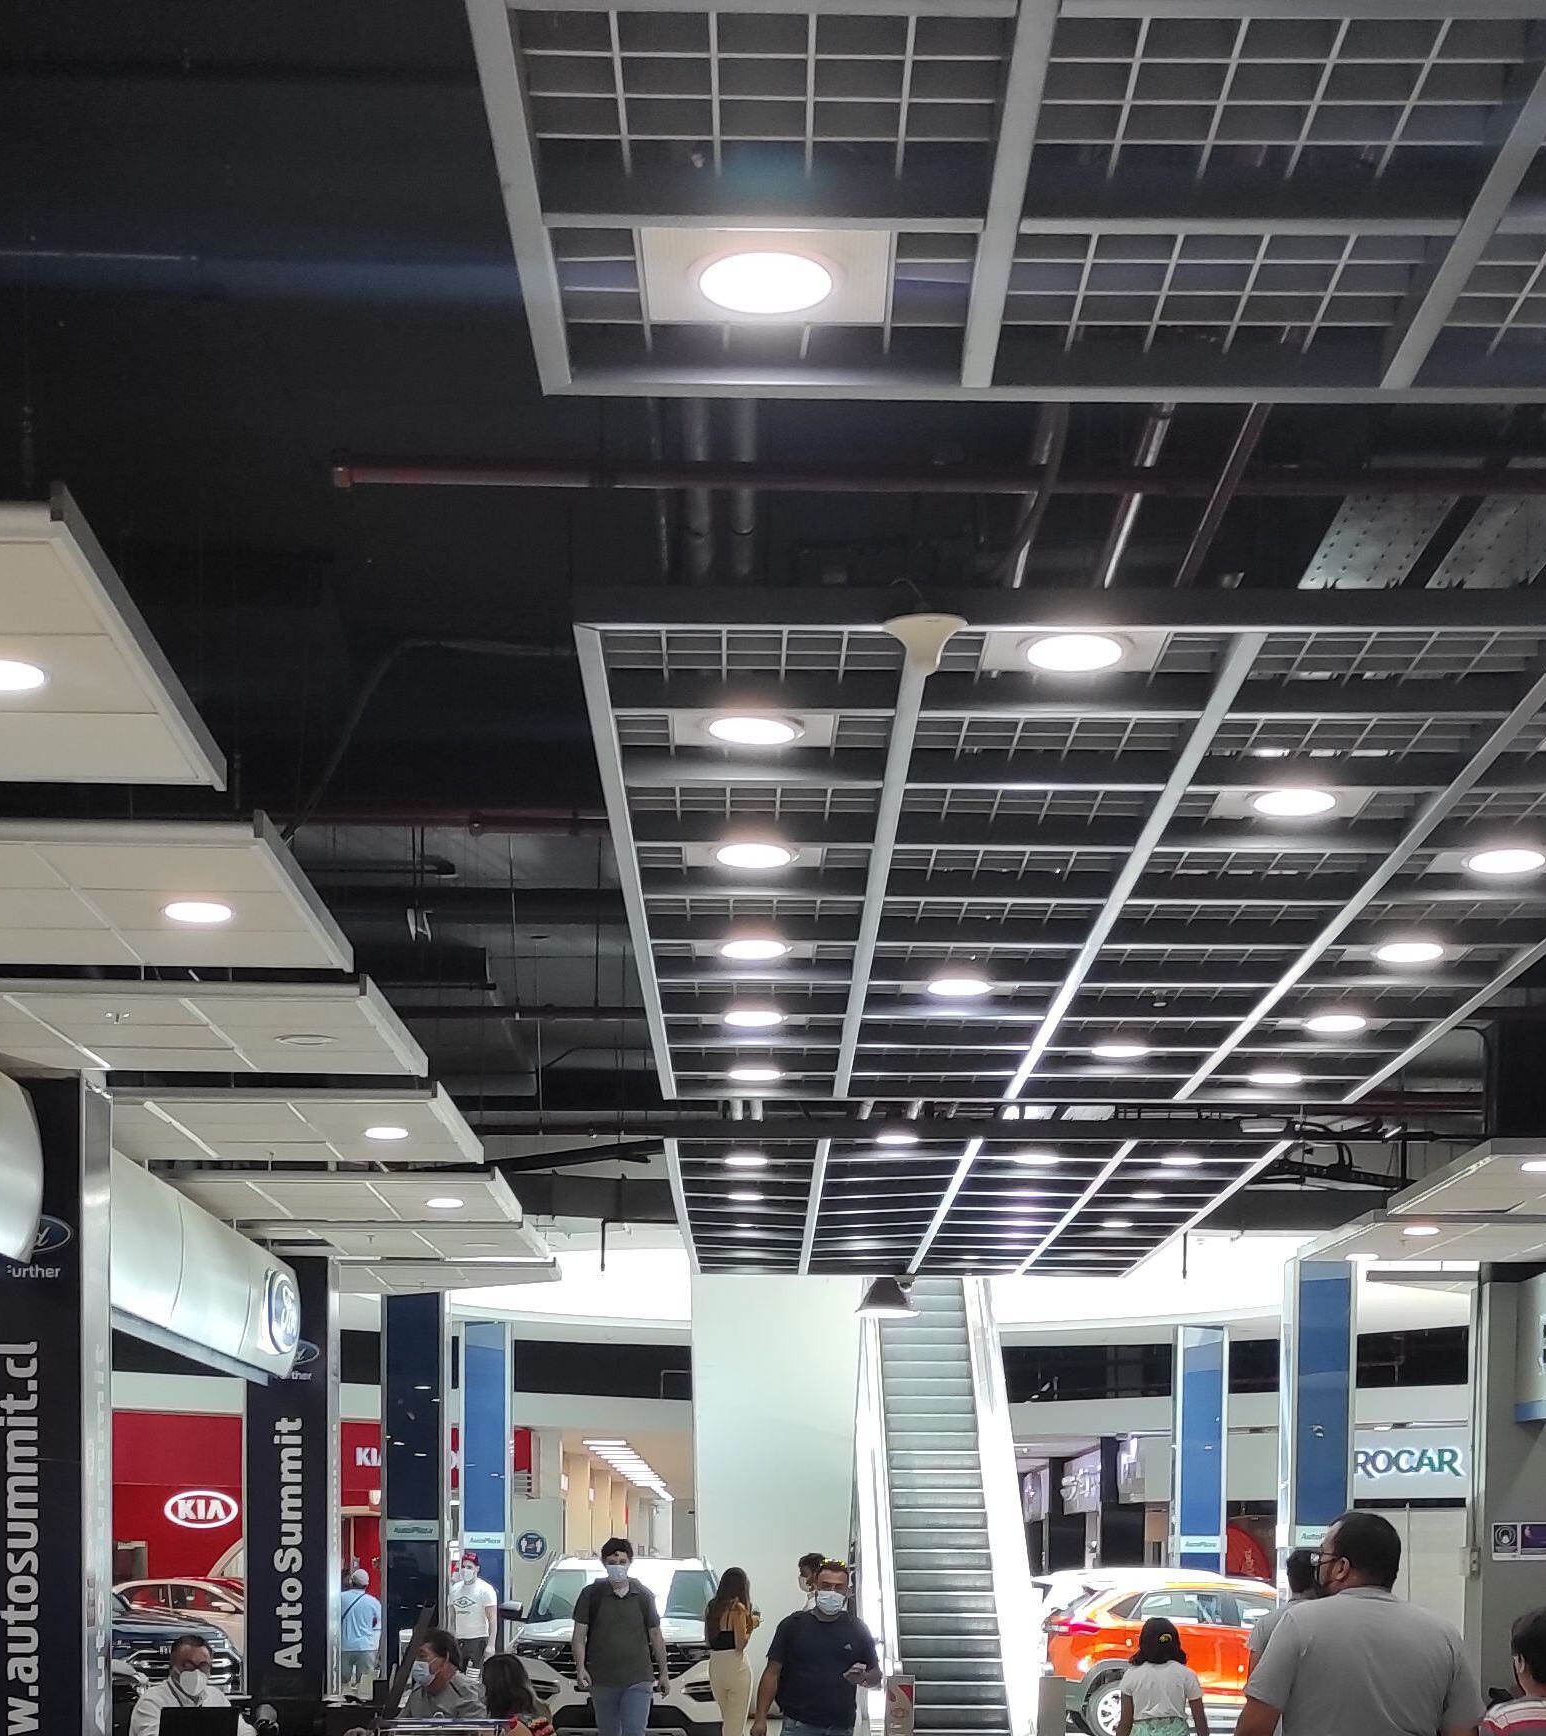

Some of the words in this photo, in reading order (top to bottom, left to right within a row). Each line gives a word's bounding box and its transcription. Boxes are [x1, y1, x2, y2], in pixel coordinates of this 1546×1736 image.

[1353, 1448, 1463, 1479] ROCAR
[176, 1498, 227, 1521] KIA
[273, 1416, 304, 1669] AutoSummit
[1301, 1532, 1326, 1541] AutoP
